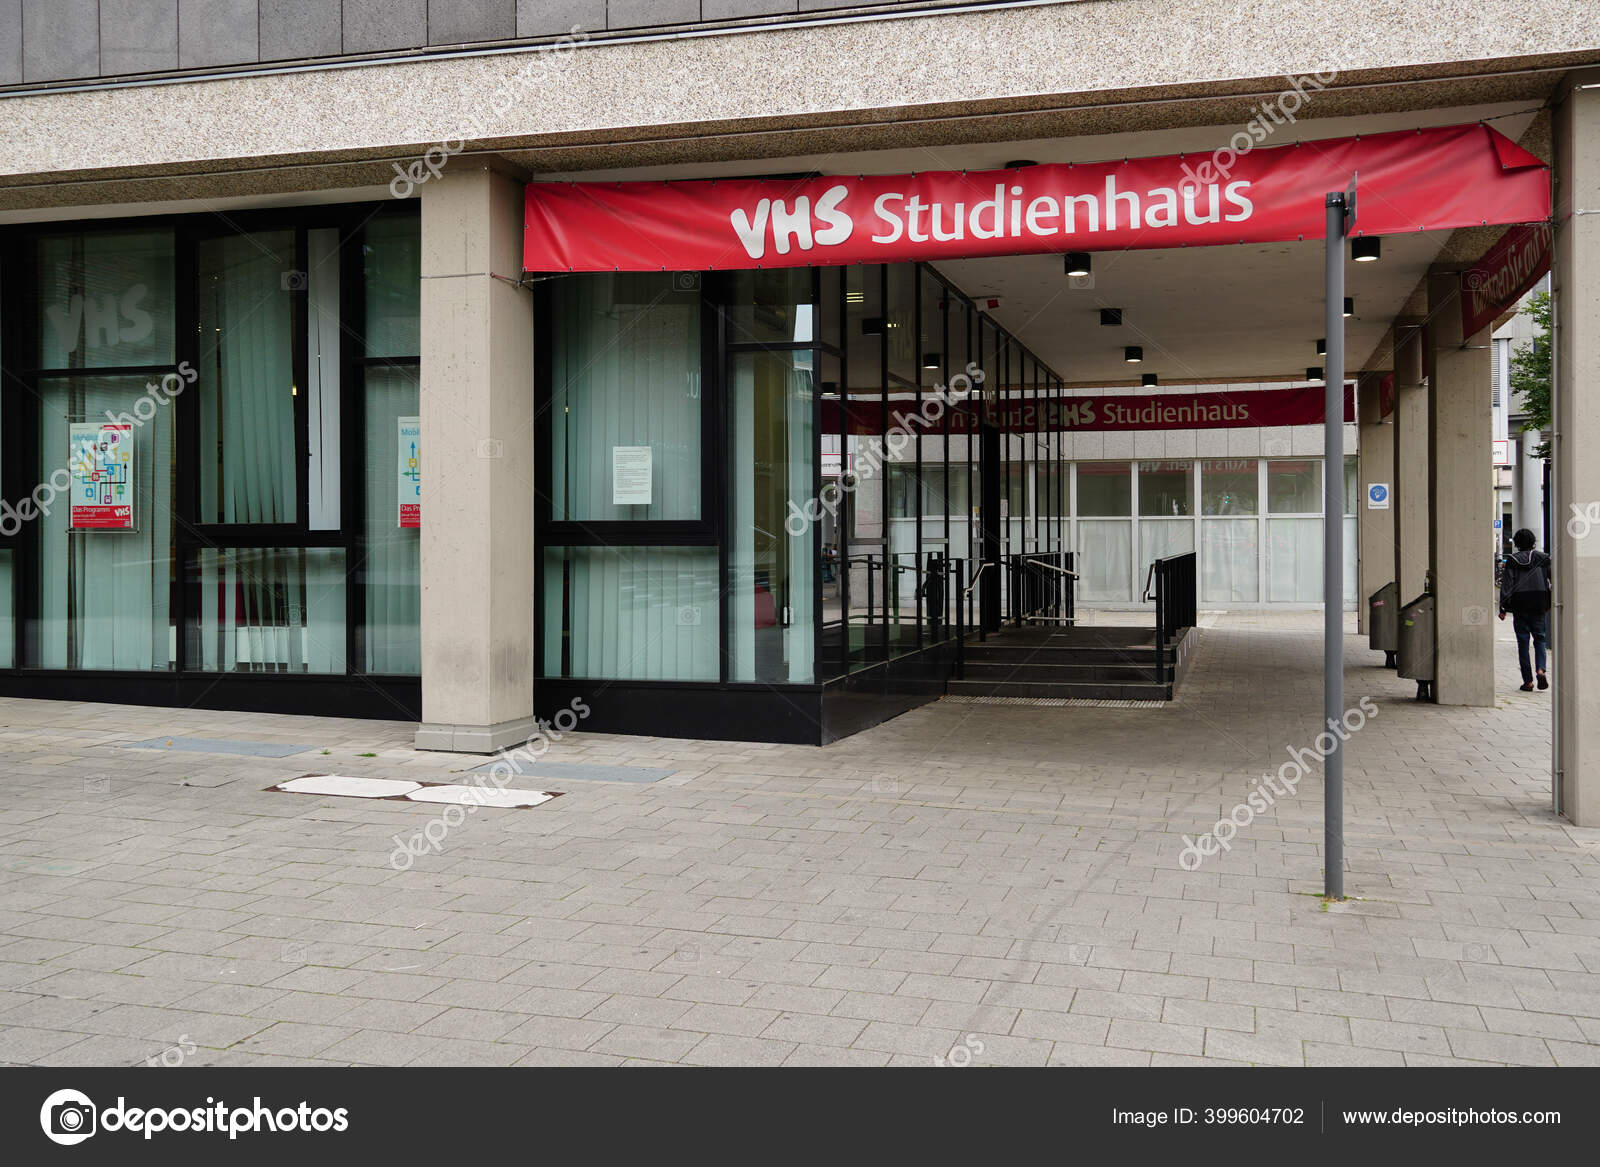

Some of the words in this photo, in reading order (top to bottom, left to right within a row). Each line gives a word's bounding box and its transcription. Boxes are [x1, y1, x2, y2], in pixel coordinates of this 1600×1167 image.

[730, 185, 854, 260] VHS
[872, 175, 1254, 244] Studienhaus
[46, 283, 153, 353] VHS
[1103, 400, 1249, 424] Studienhaus
[114, 506, 130, 517] VHS
